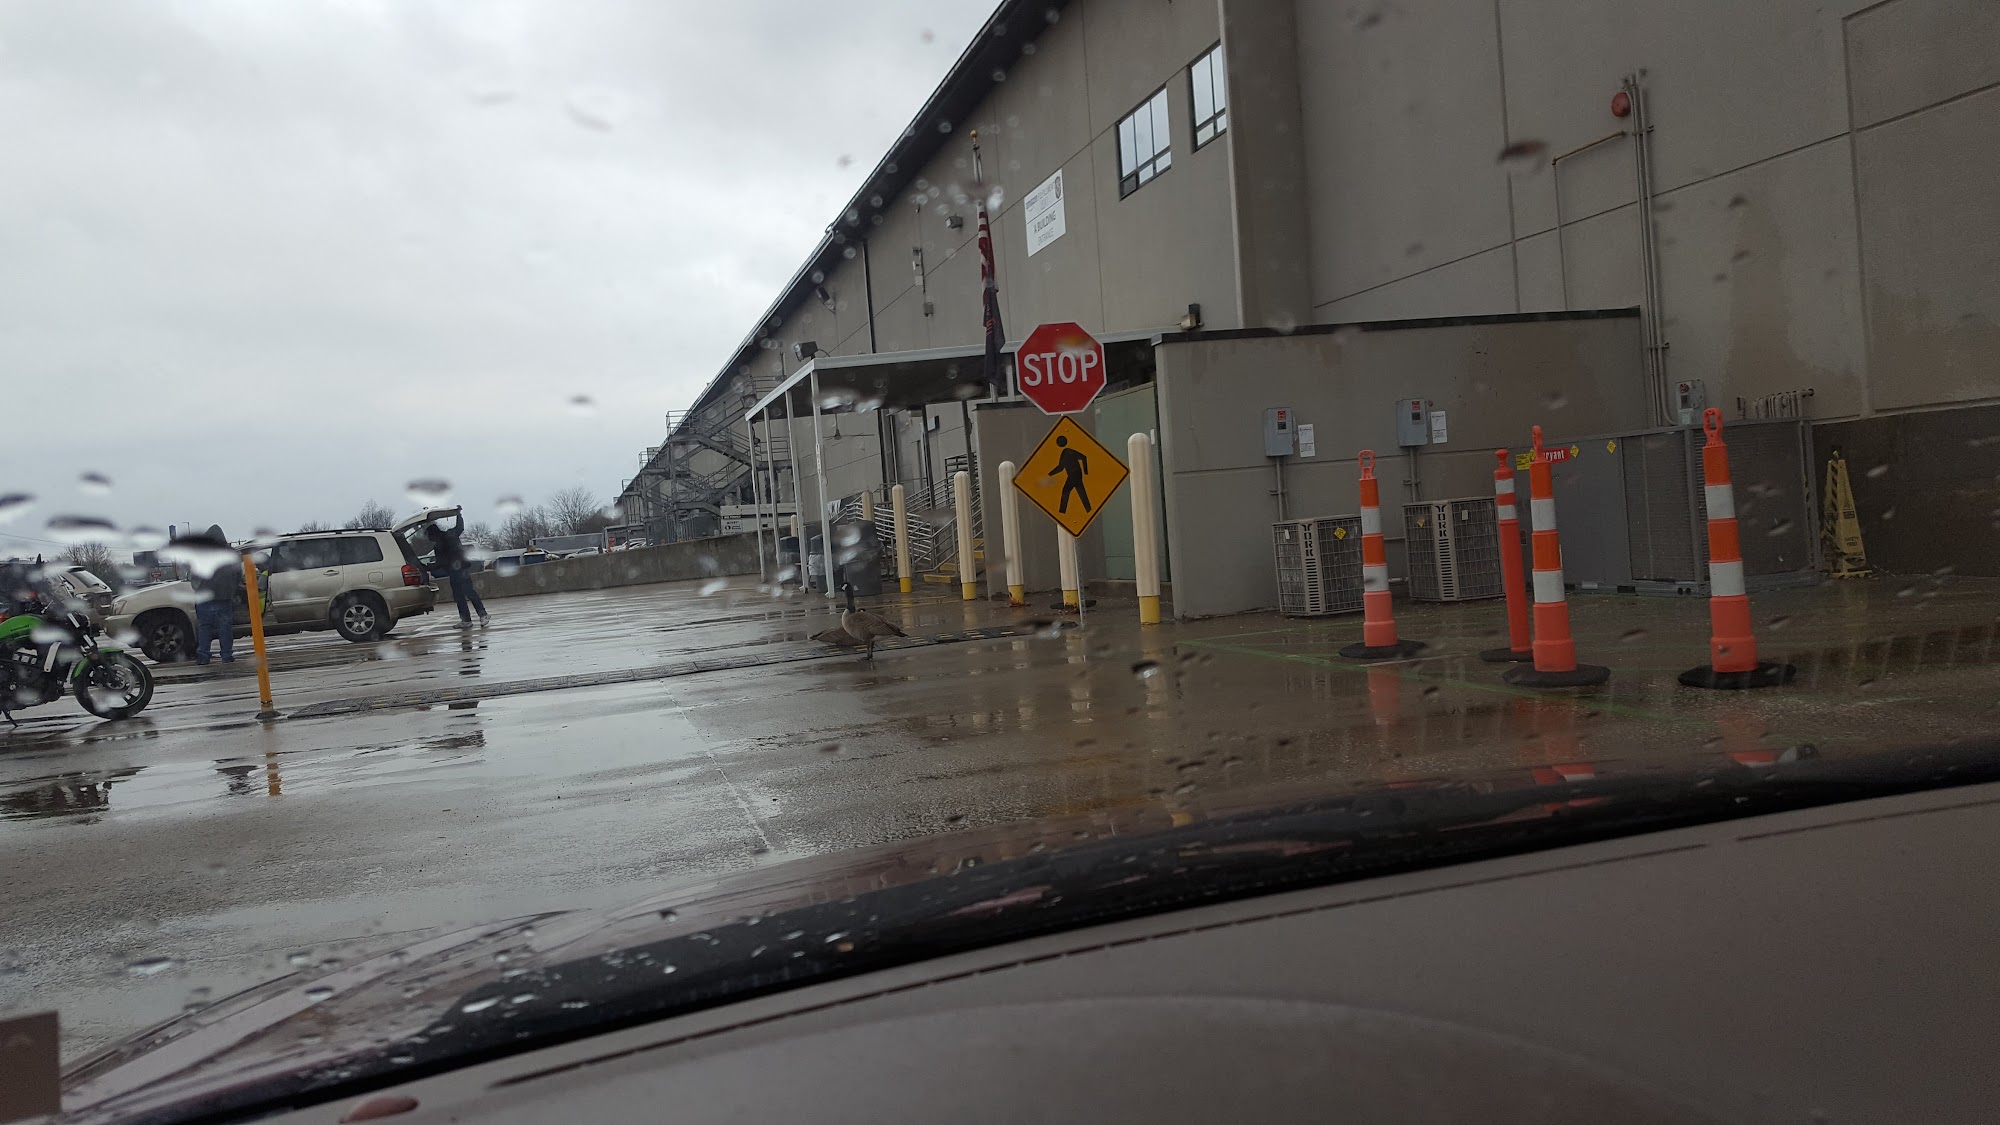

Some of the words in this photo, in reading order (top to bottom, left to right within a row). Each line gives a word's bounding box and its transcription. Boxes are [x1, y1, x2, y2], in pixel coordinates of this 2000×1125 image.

[1037, 211, 1056, 232] BUILDING
[1023, 350, 1098, 386] STOP
[1544, 449, 1565, 462] ryant
[1435, 504, 1447, 537] YORK
[1302, 523, 1314, 557] YORK
